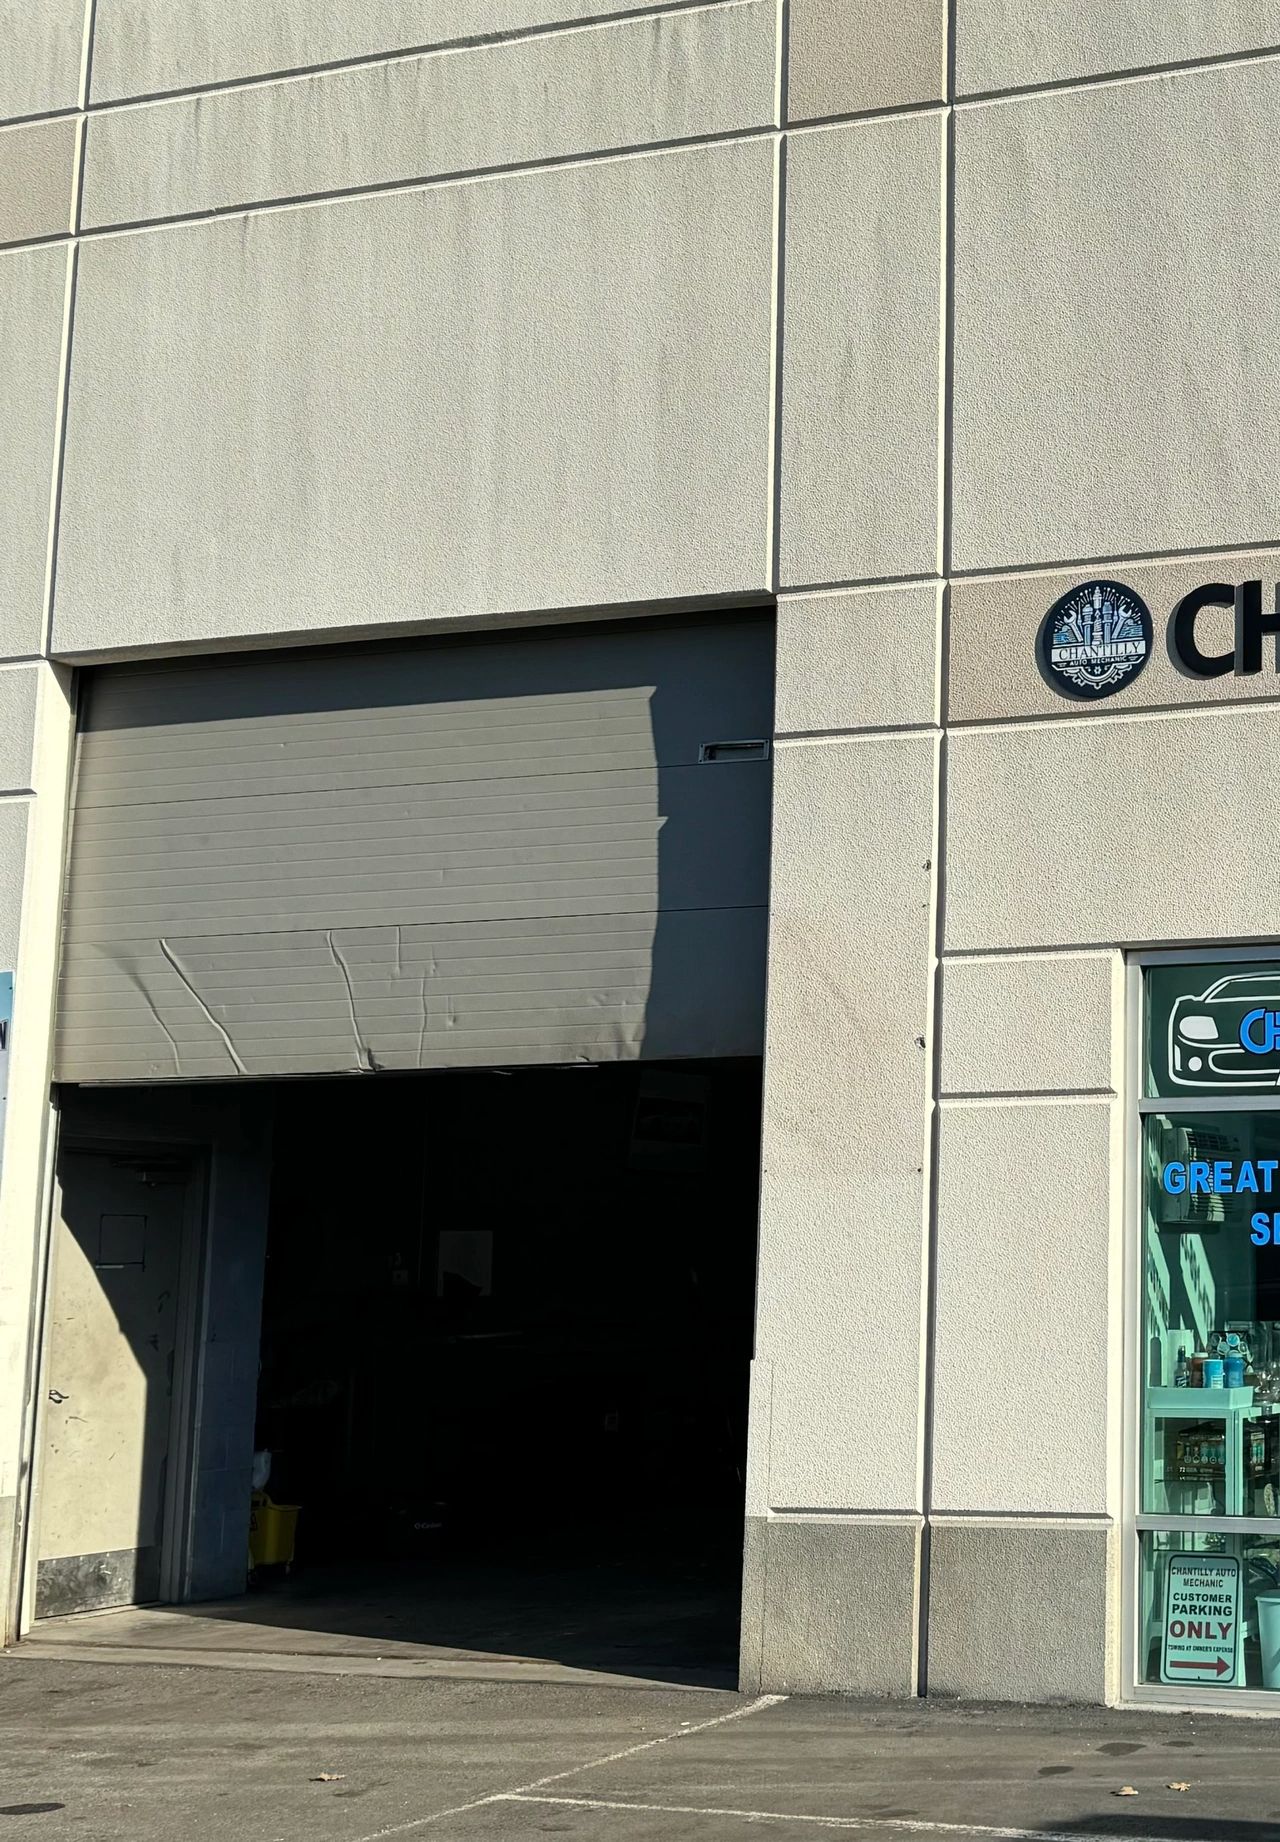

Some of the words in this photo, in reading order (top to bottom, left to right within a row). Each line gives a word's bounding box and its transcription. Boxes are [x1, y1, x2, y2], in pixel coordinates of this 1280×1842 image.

[1059, 642, 1141, 661] CHANTILLY
[1091, 656, 1127, 665] MECHANIC
[1163, 1160, 1278, 1195] GREAT
[1171, 1566, 1213, 1576] CHANTILLY
[1215, 1568, 1236, 1578] AUTO
[1183, 1578, 1223, 1588] MECHANIC
[1173, 1593, 1232, 1603] CUSTOMER
[1172, 1604, 1232, 1616] PARKING
[1169, 1620, 1233, 1640] ONLY
